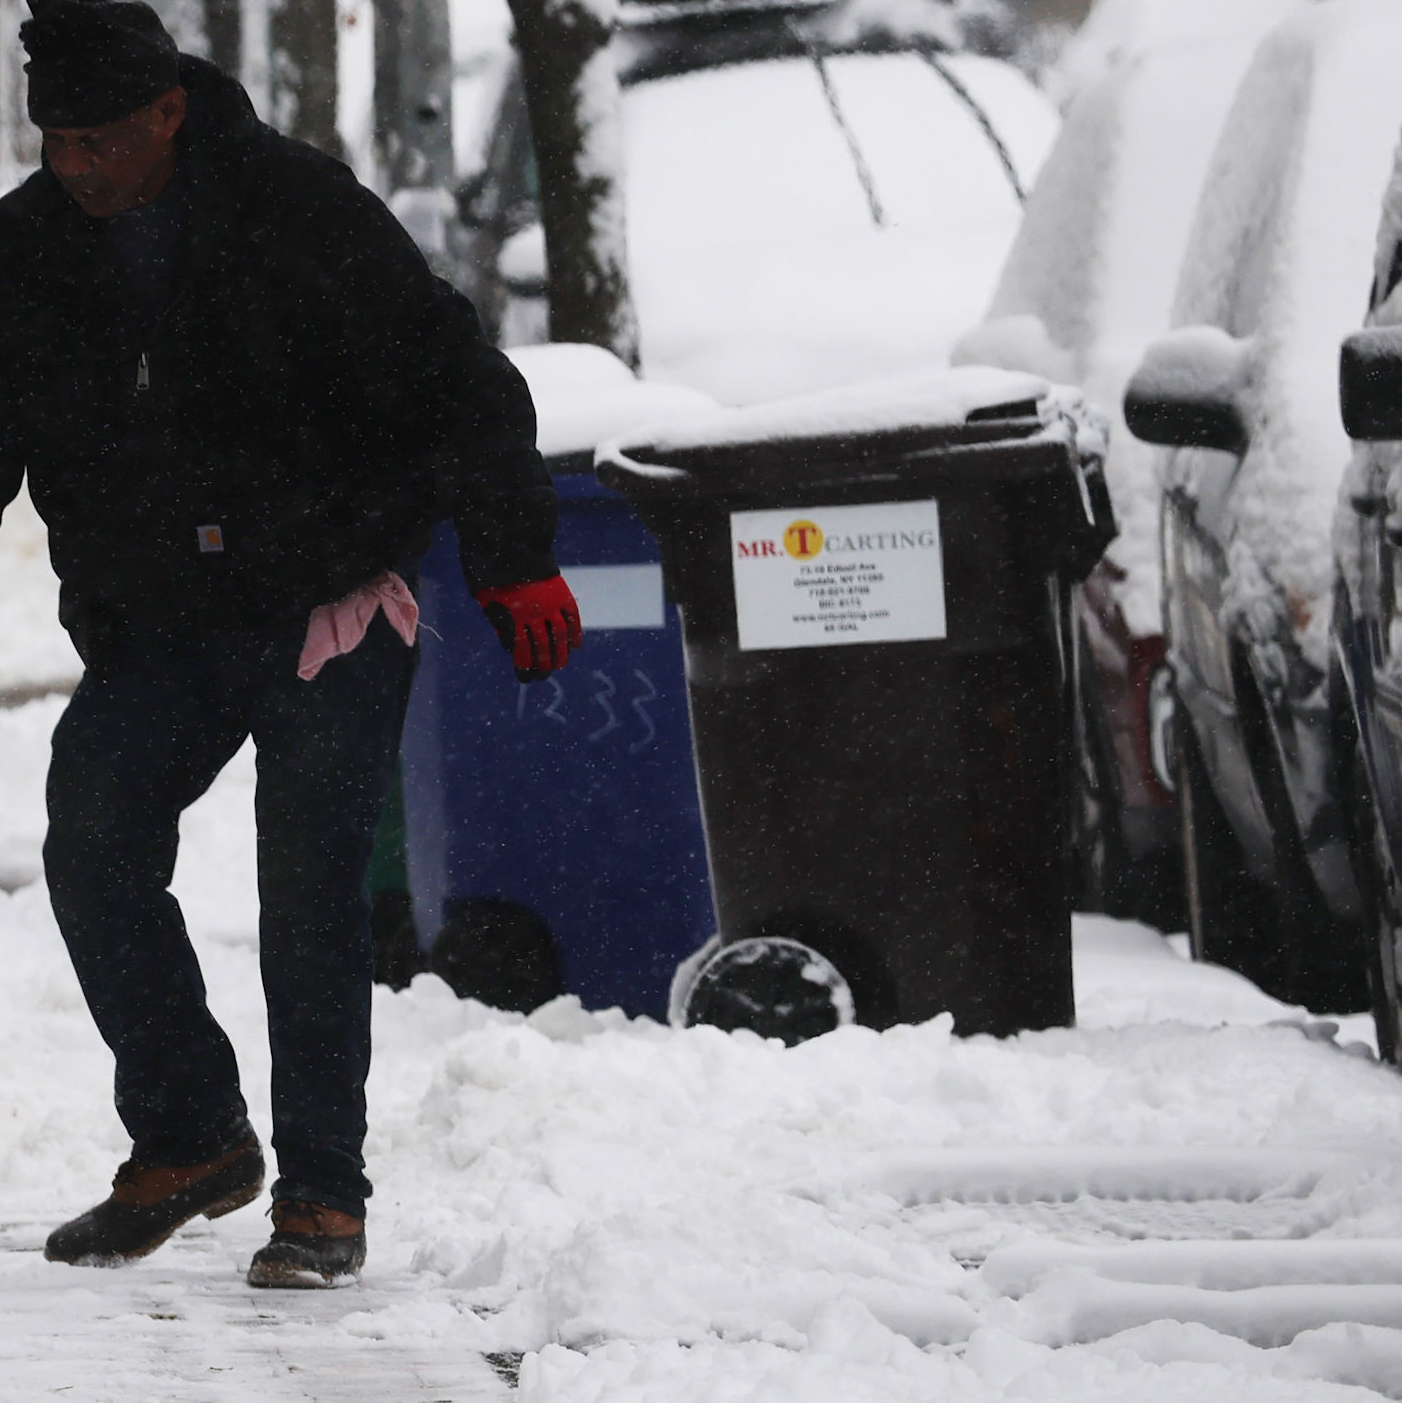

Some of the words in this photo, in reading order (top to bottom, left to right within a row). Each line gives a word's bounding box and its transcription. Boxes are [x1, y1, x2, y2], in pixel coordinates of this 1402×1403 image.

[737, 539, 784, 558] MR.
[788, 525, 817, 556] T
[824, 529, 935, 554] CARTING
